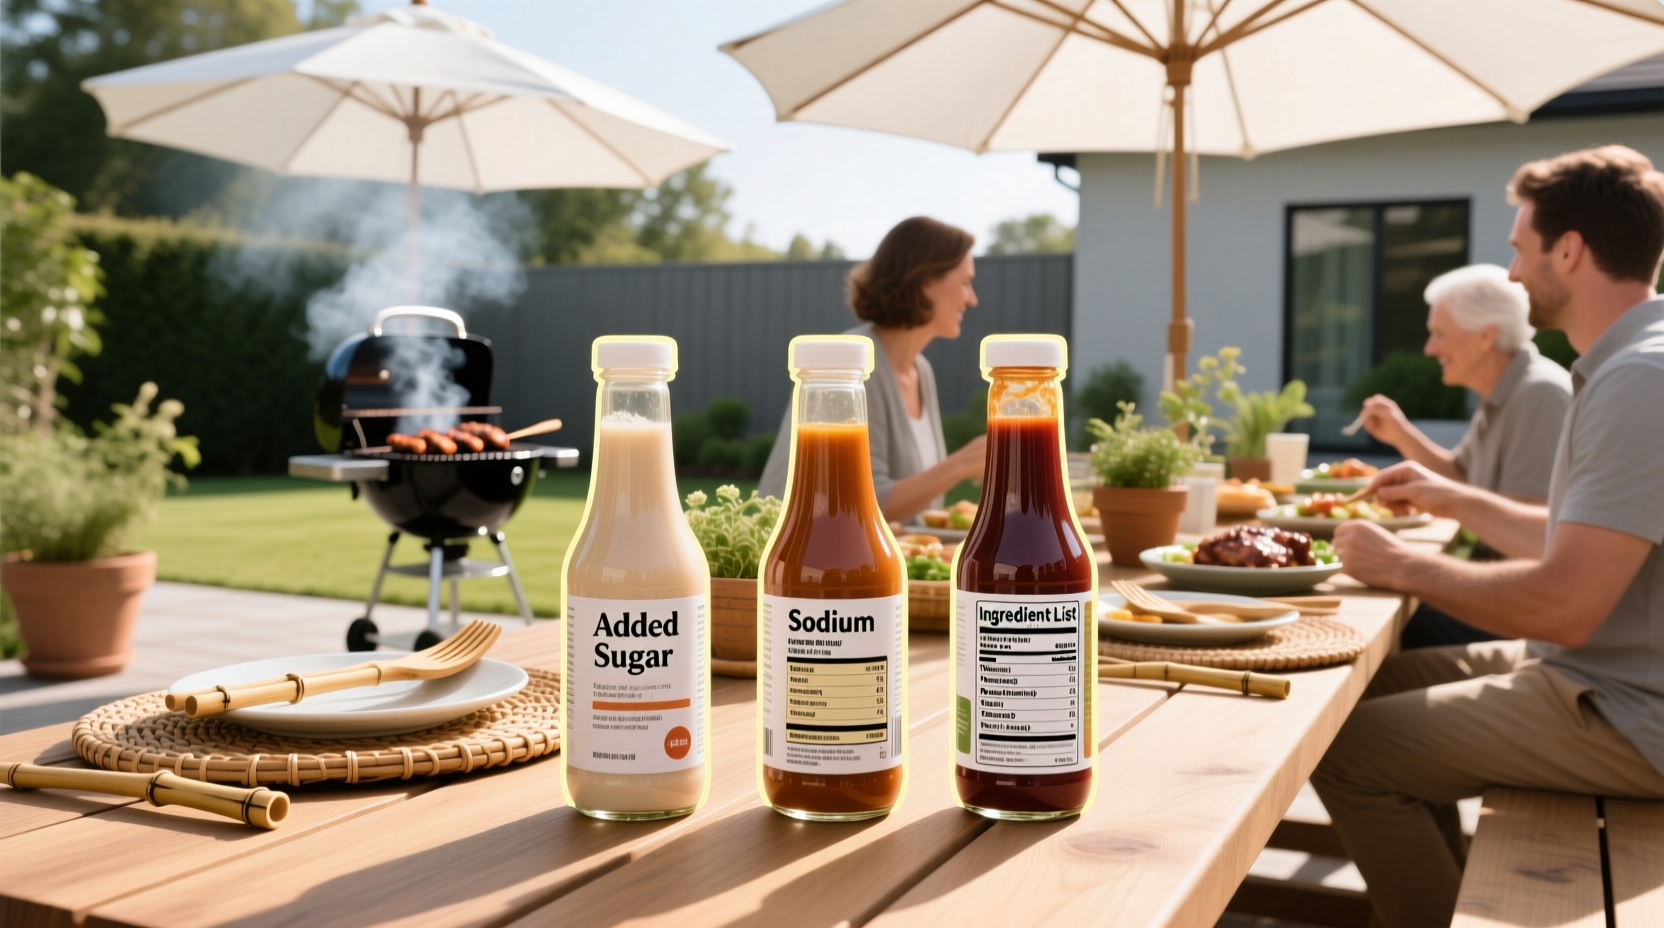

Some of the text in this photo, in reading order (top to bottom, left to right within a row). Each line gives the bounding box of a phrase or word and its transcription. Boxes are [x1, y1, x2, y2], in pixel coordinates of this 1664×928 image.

[593, 611, 679, 637] Added
[788, 608, 875, 633] Sodium
[979, 606, 1077, 626] Ingredient List
[594, 642, 673, 675] Sugar
